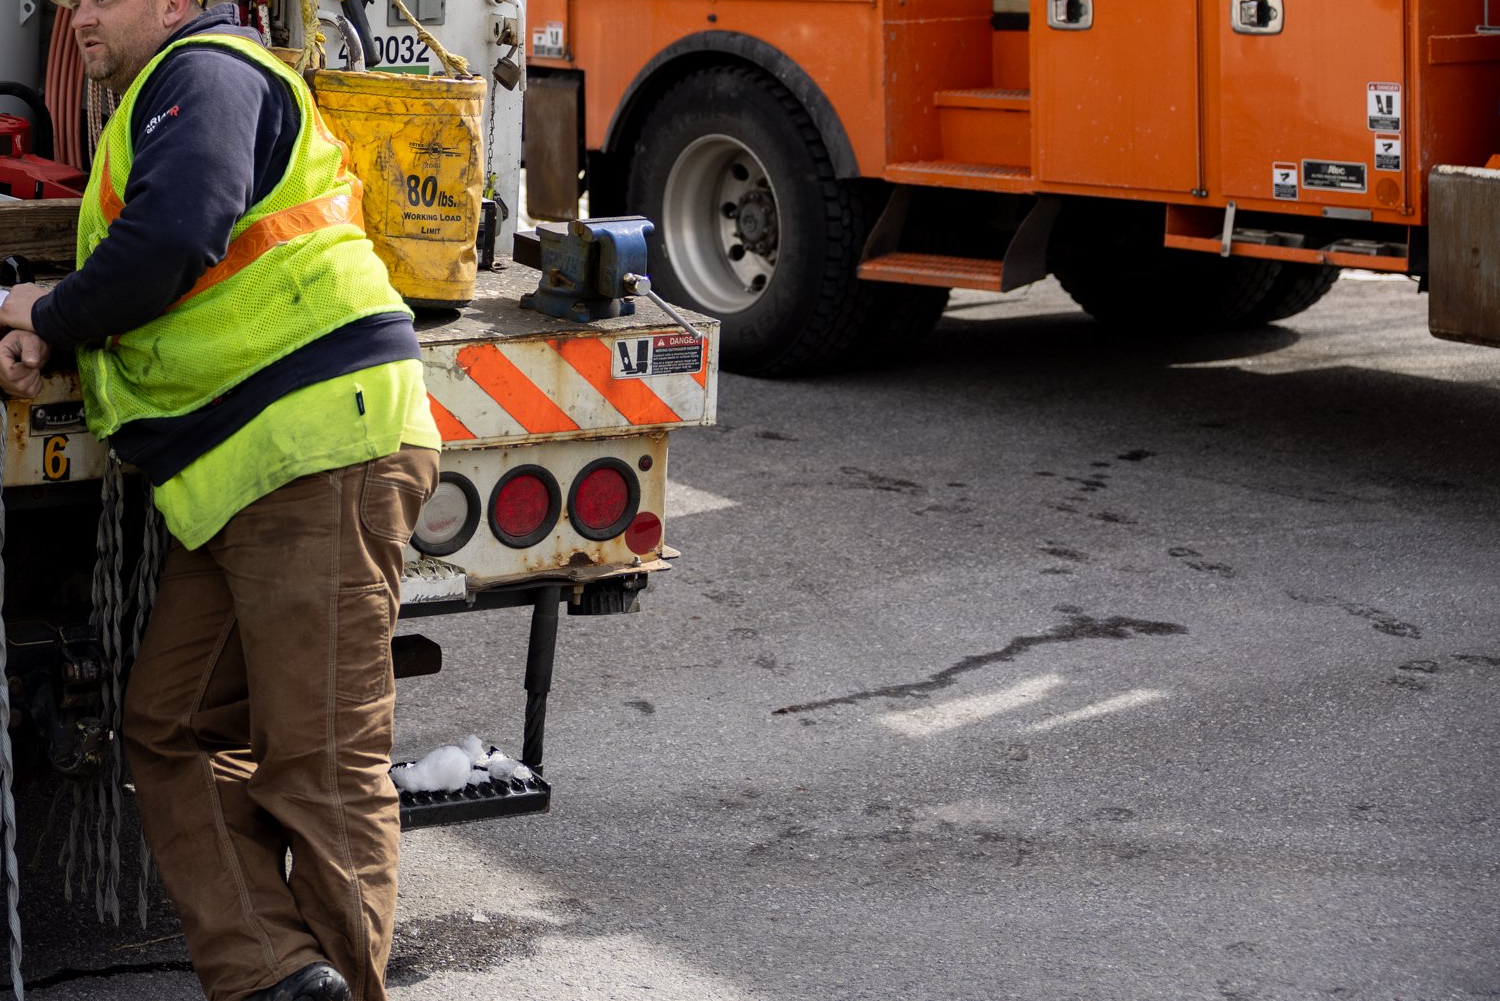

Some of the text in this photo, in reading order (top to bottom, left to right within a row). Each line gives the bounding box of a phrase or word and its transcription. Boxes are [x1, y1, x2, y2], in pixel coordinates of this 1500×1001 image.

[406, 174, 457, 208] 80 lbs.
[403, 211, 462, 222] WORKING LOAD
[420, 226, 441, 235] LIMIT
[44, 435, 68, 479] 6
